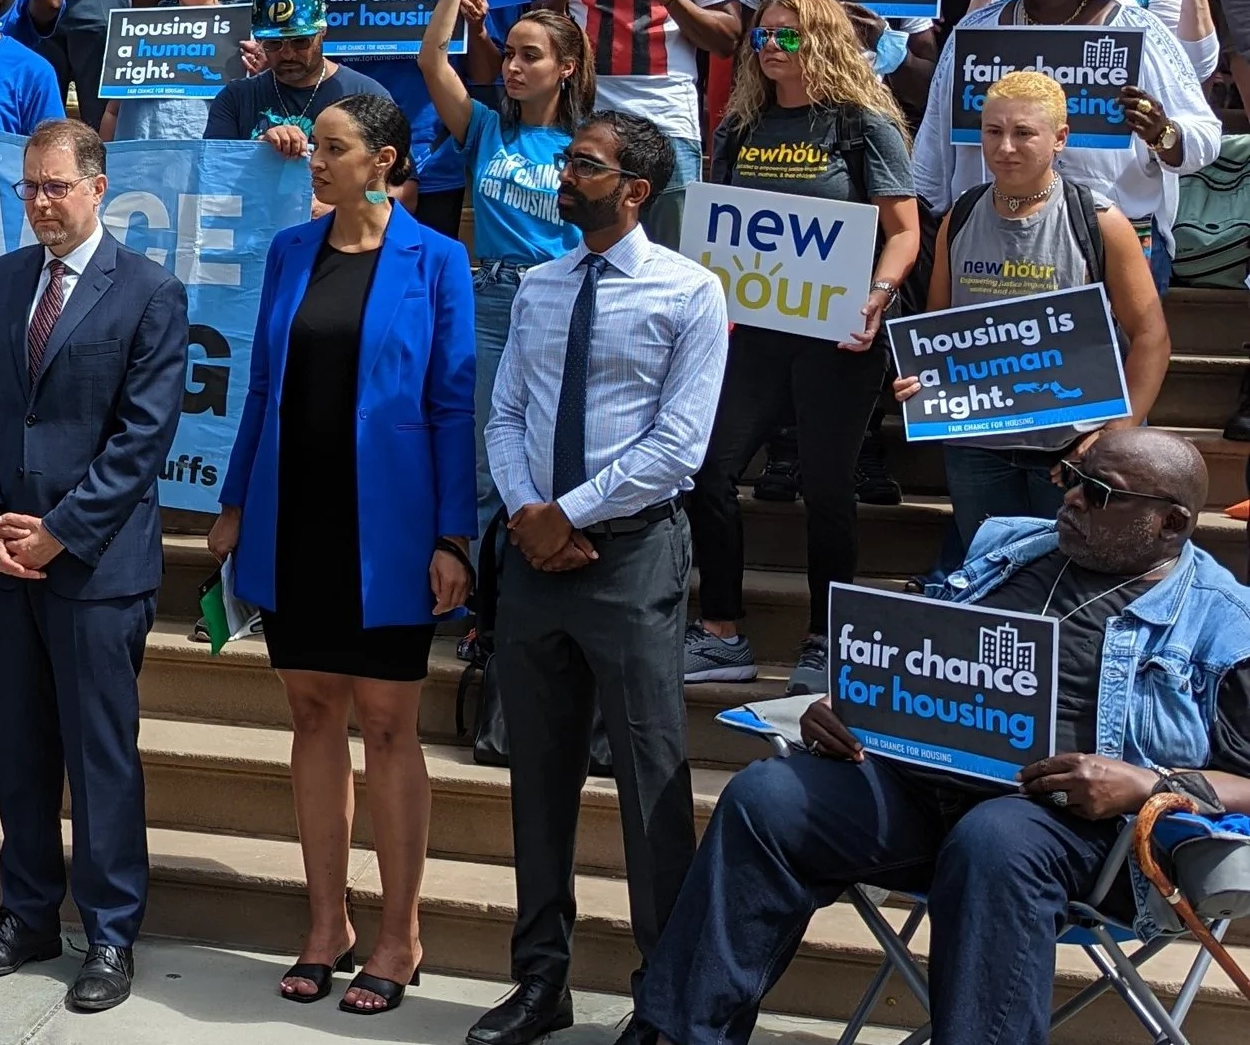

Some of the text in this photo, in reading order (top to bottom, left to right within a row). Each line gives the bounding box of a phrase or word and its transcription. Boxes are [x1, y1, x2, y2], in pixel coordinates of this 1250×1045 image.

[121, 15, 231, 40] housing is
[118, 40, 216, 58] a human
[116, 60, 176, 85] right.
[478, 177, 502, 200] FOR
[484, 158, 561, 191] FAIR CHANC
[707, 202, 845, 261] new
[702, 252, 848, 321] hour
[909, 307, 1075, 356] housing is
[919, 348, 1063, 388] a human
[924, 384, 1014, 420] right.
[948, 417, 1034, 433] FAIR CHANCE FOR HOUSING
[839, 624, 1038, 697] fair chance
[839, 665, 1035, 749] for housing
[865, 736, 952, 763] FAIR CHANCE FOR HOUSING
